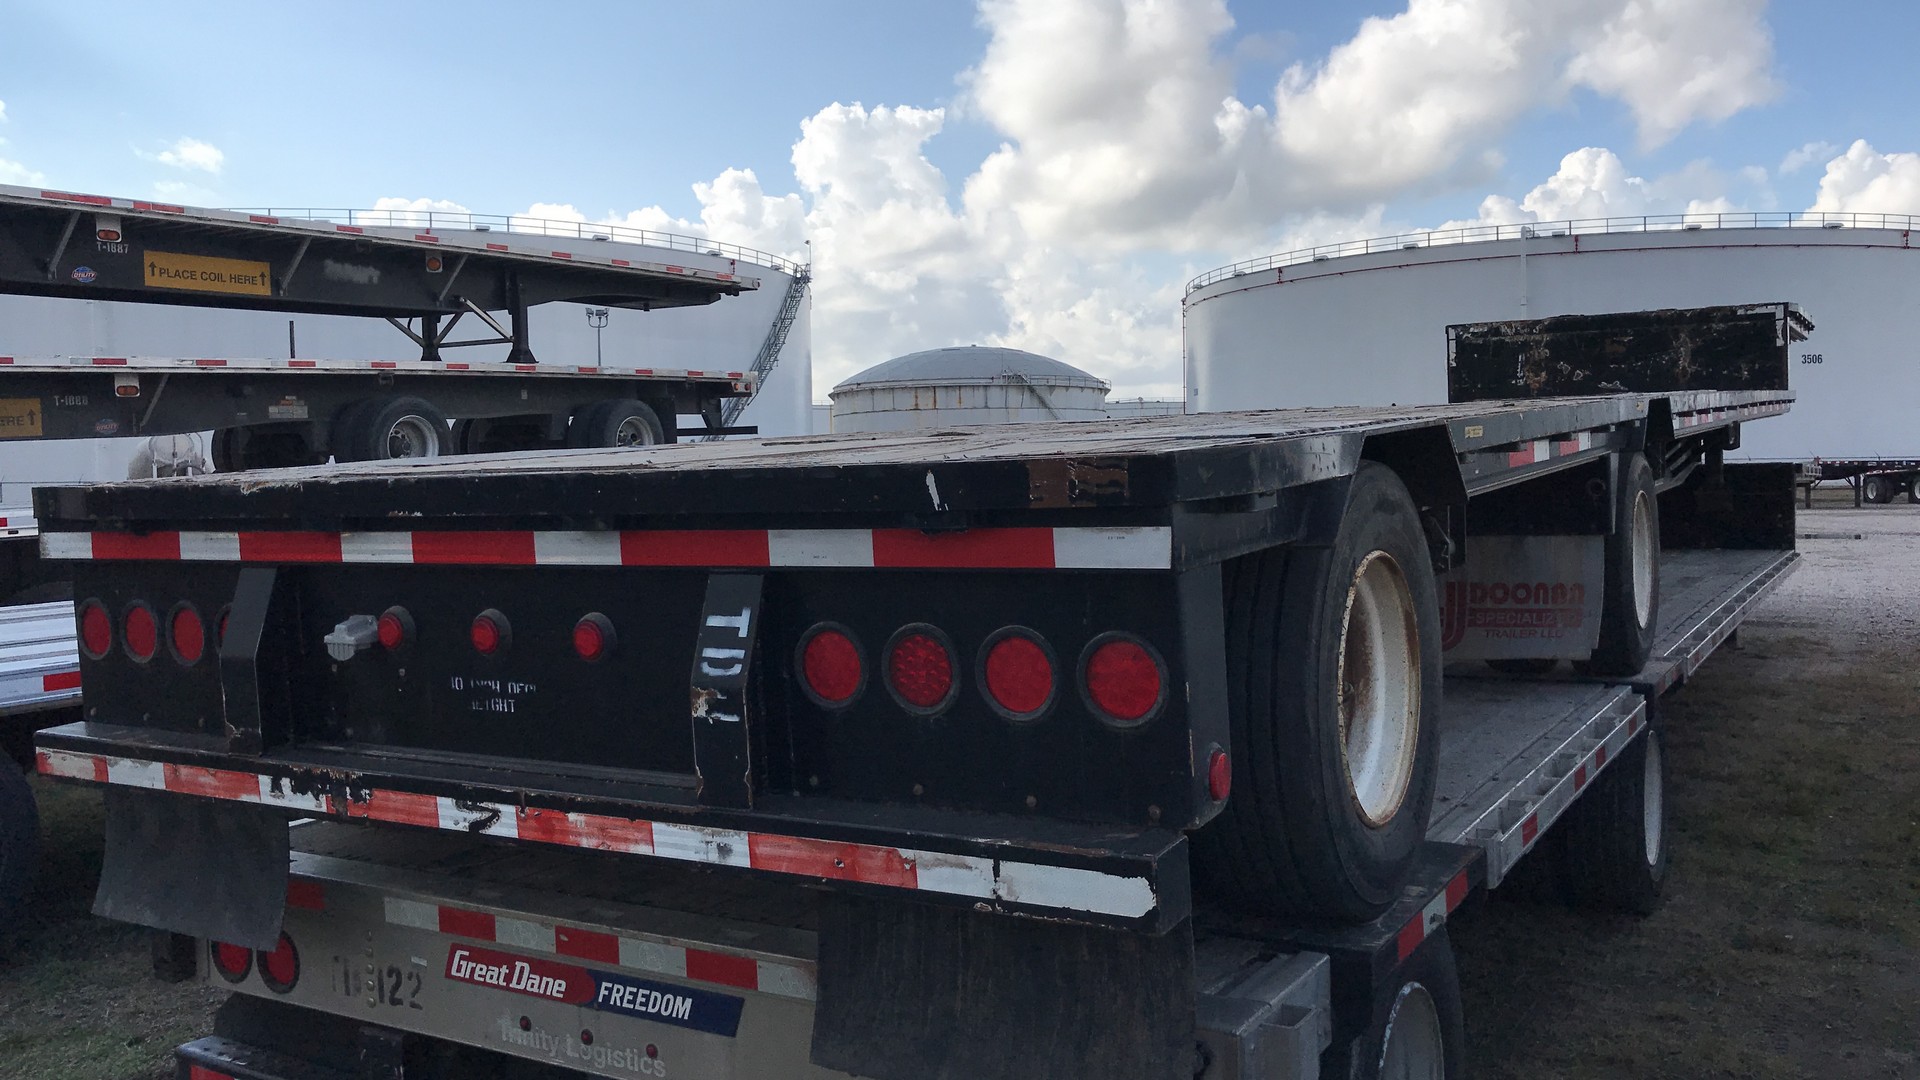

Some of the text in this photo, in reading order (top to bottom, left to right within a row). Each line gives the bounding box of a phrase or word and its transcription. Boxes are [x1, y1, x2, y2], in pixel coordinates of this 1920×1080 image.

[96, 242, 129, 254] T-1887
[159, 267, 258, 286] PLACE COIL HERE
[1801, 354, 1823, 364] 3506
[1475, 612, 1576, 625] SPECIALIZ
[1485, 629, 1537, 639] TRAILER
[451, 949, 567, 998] Great Dane
[598, 981, 693, 1020] FREEDOM
[565, 1033, 667, 1079] Logistics
